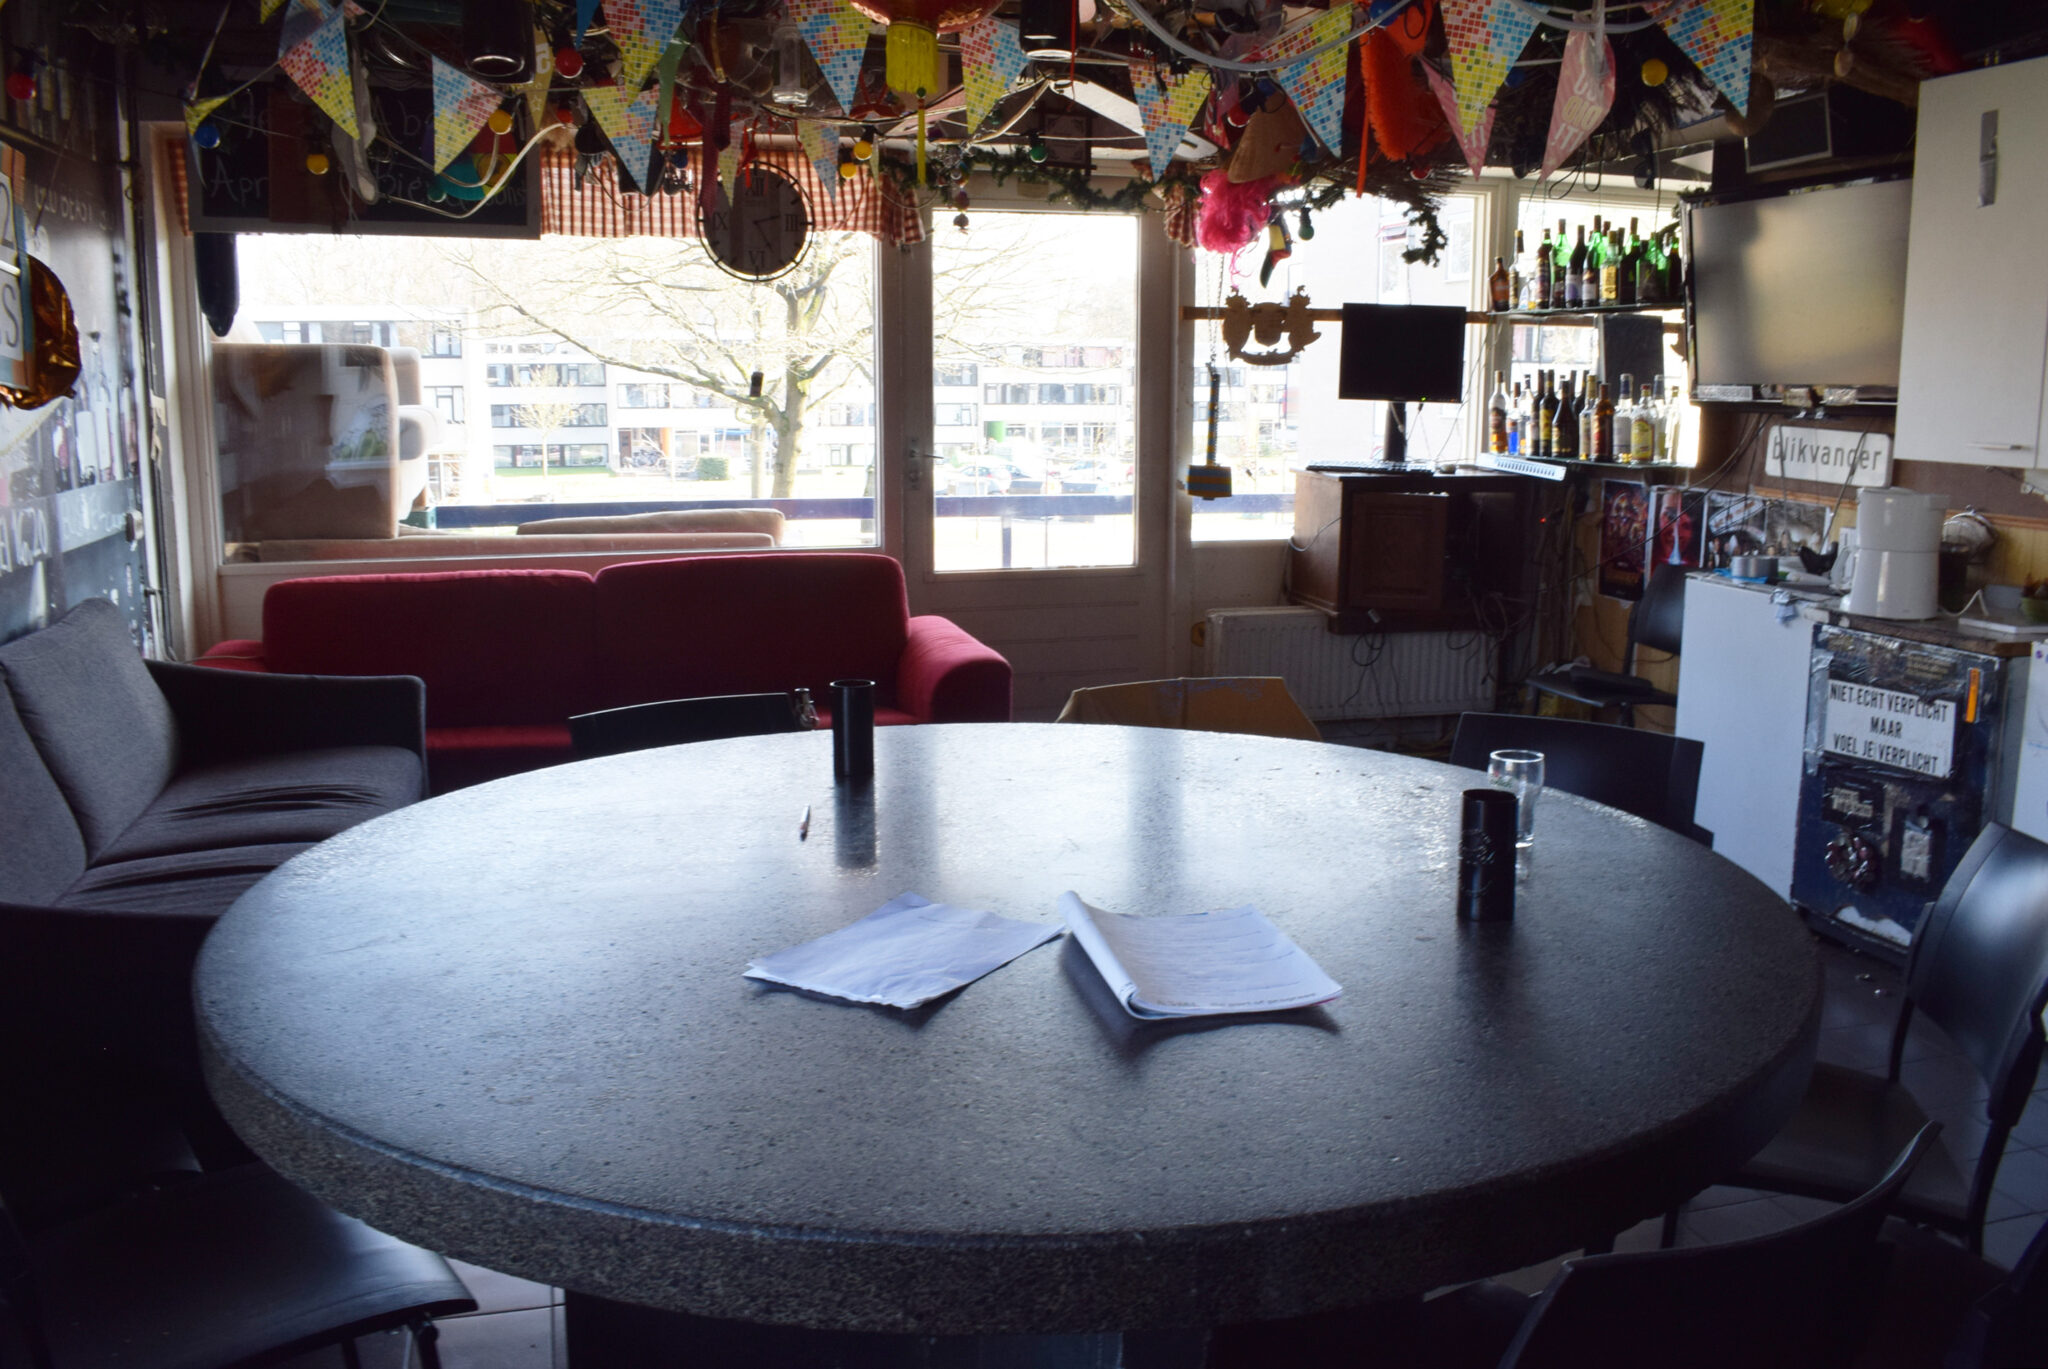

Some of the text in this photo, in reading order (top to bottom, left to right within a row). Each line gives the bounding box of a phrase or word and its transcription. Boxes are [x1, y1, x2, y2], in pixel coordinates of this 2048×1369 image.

[785, 214, 799, 232] III
[1830, 683, 1949, 722] NIET ECHT VERPLICHT
[1871, 716, 1902, 738] MAAR
[1834, 734, 1938, 773] VOEL JE VERPLICHT
